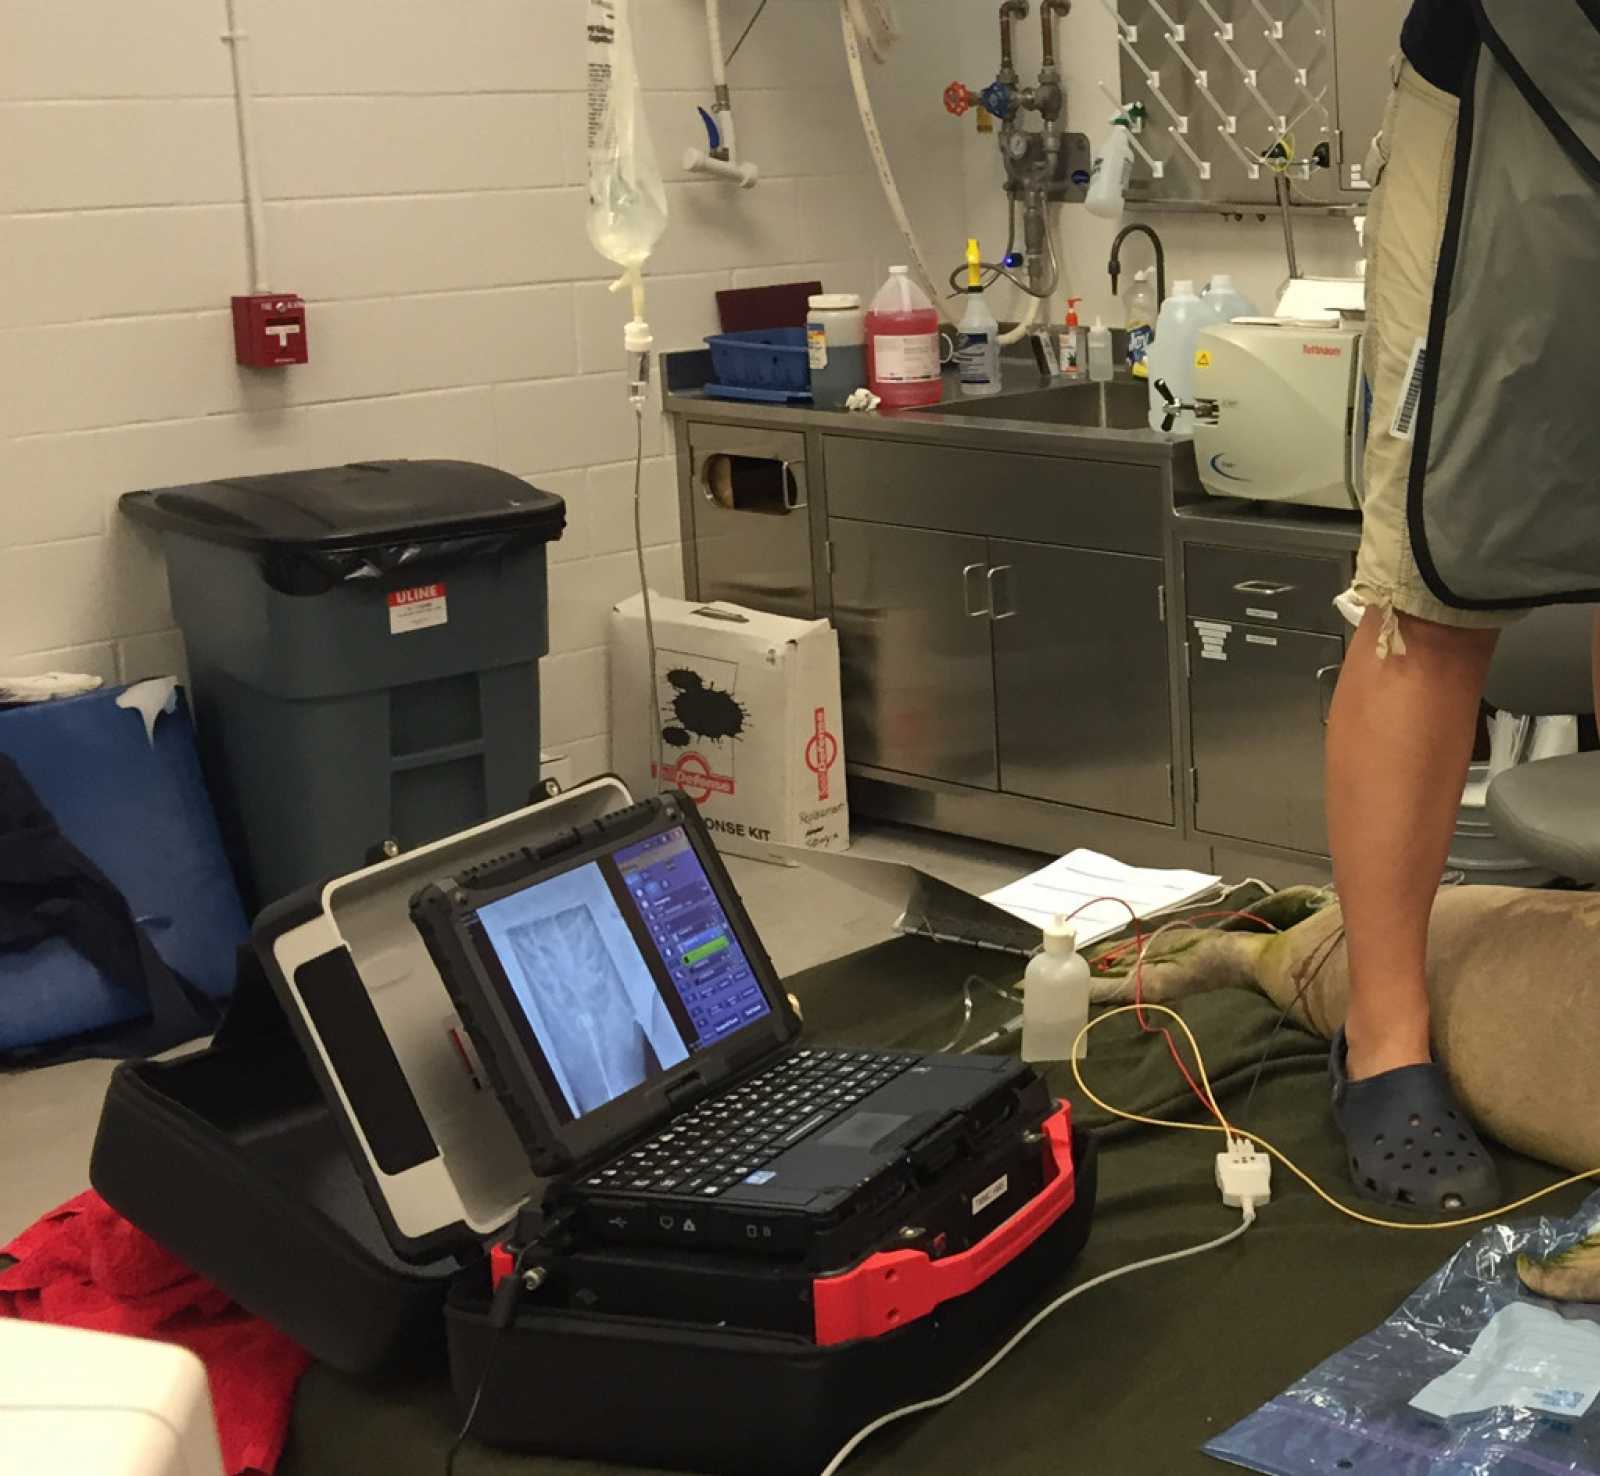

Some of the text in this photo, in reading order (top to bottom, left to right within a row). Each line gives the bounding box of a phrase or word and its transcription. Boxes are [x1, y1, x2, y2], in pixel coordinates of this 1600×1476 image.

[396, 585, 438, 603] ULINE
[704, 817, 771, 841] ONSE KIT
